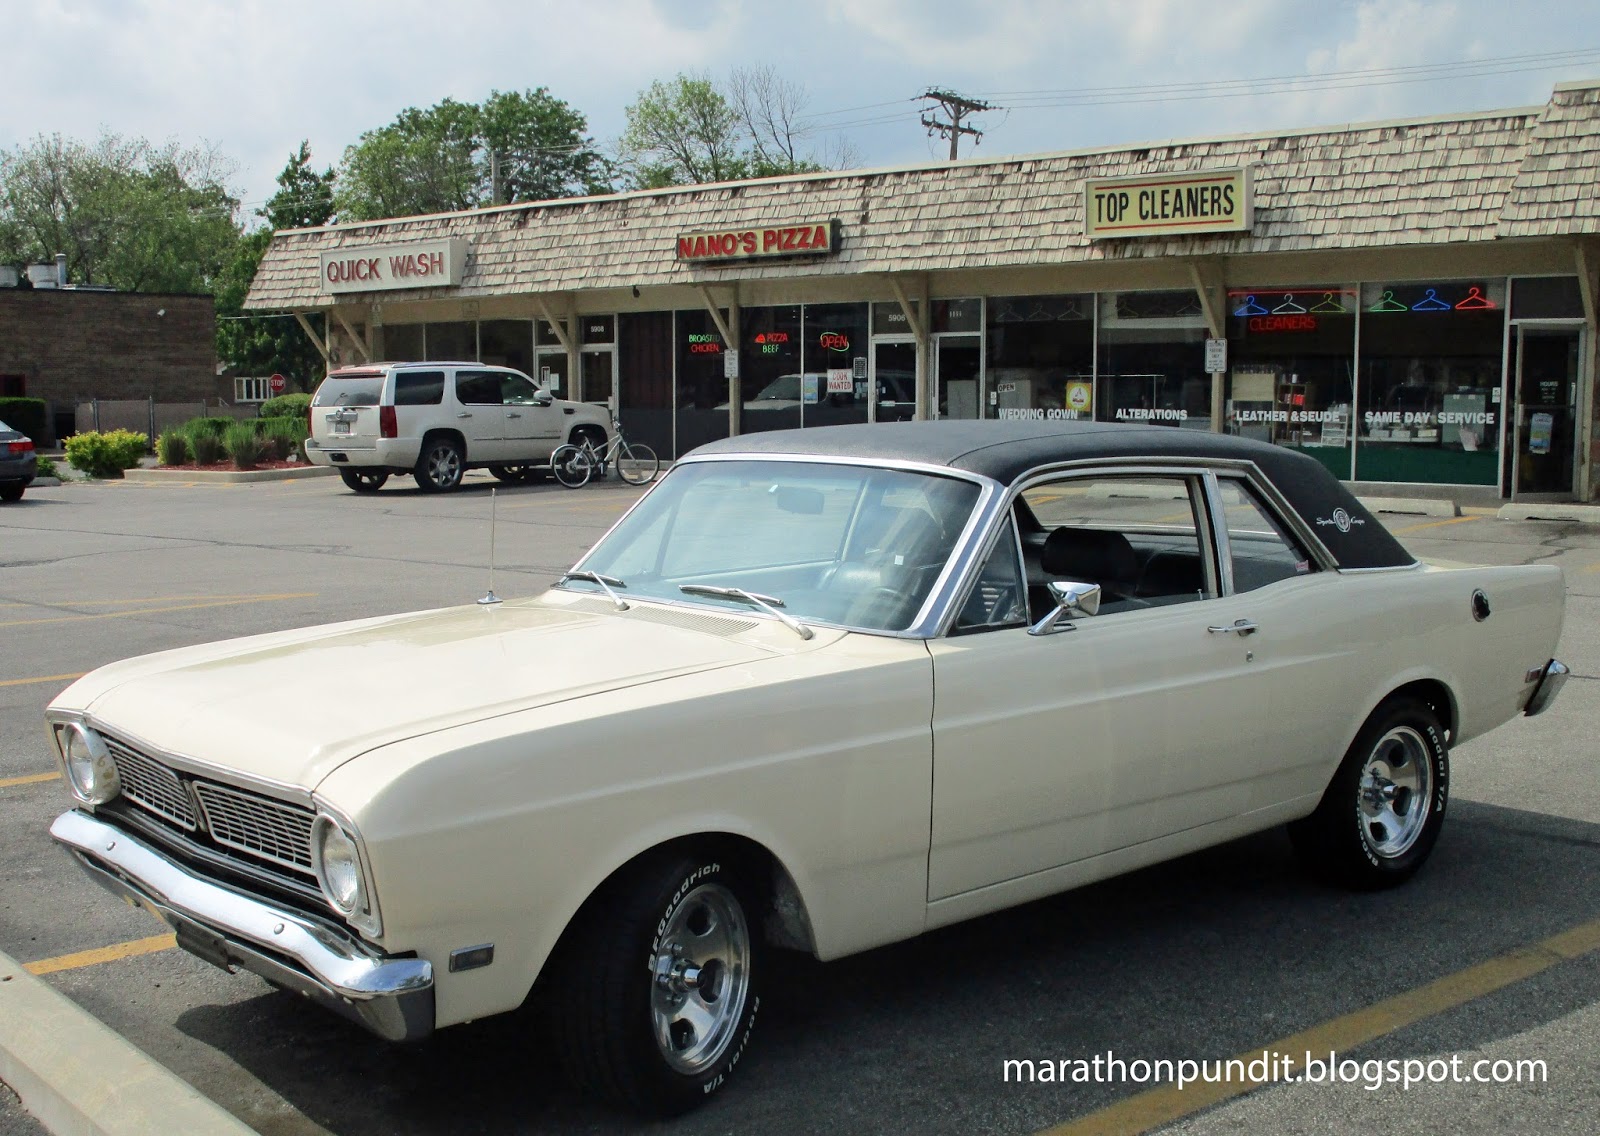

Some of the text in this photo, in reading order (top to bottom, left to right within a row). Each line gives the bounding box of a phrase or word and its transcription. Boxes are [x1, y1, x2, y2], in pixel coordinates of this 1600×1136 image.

[1095, 184, 1234, 223] TOP CLEANERS
[678, 225, 829, 259] NANO'S PIZZA
[326, 251, 444, 282] QUICK WASH
[1249, 316, 1316, 331] CLEANERS
[767, 333, 788, 342] PIZZA
[821, 335, 848, 348] OPEN
[690, 344, 720, 353] CHICKEN
[762, 344, 779, 353] BEEF
[832, 371, 848, 381] COOK
[270, 379, 285, 387] STOP
[828, 381, 852, 390] WANTED
[998, 383, 1015, 392] OPEN
[998, 408, 1078, 420] WEDDING GOWN
[1115, 408, 1188, 421] ALTERATIONS
[1236, 410, 1288, 422] LEATHER
[1364, 411, 1495, 425] SAME DAY SERVICE
[1436, 784, 1445, 812] T/A
[648, 862, 721, 972] BFGoodrich
[703, 1073, 725, 1094] T/A
